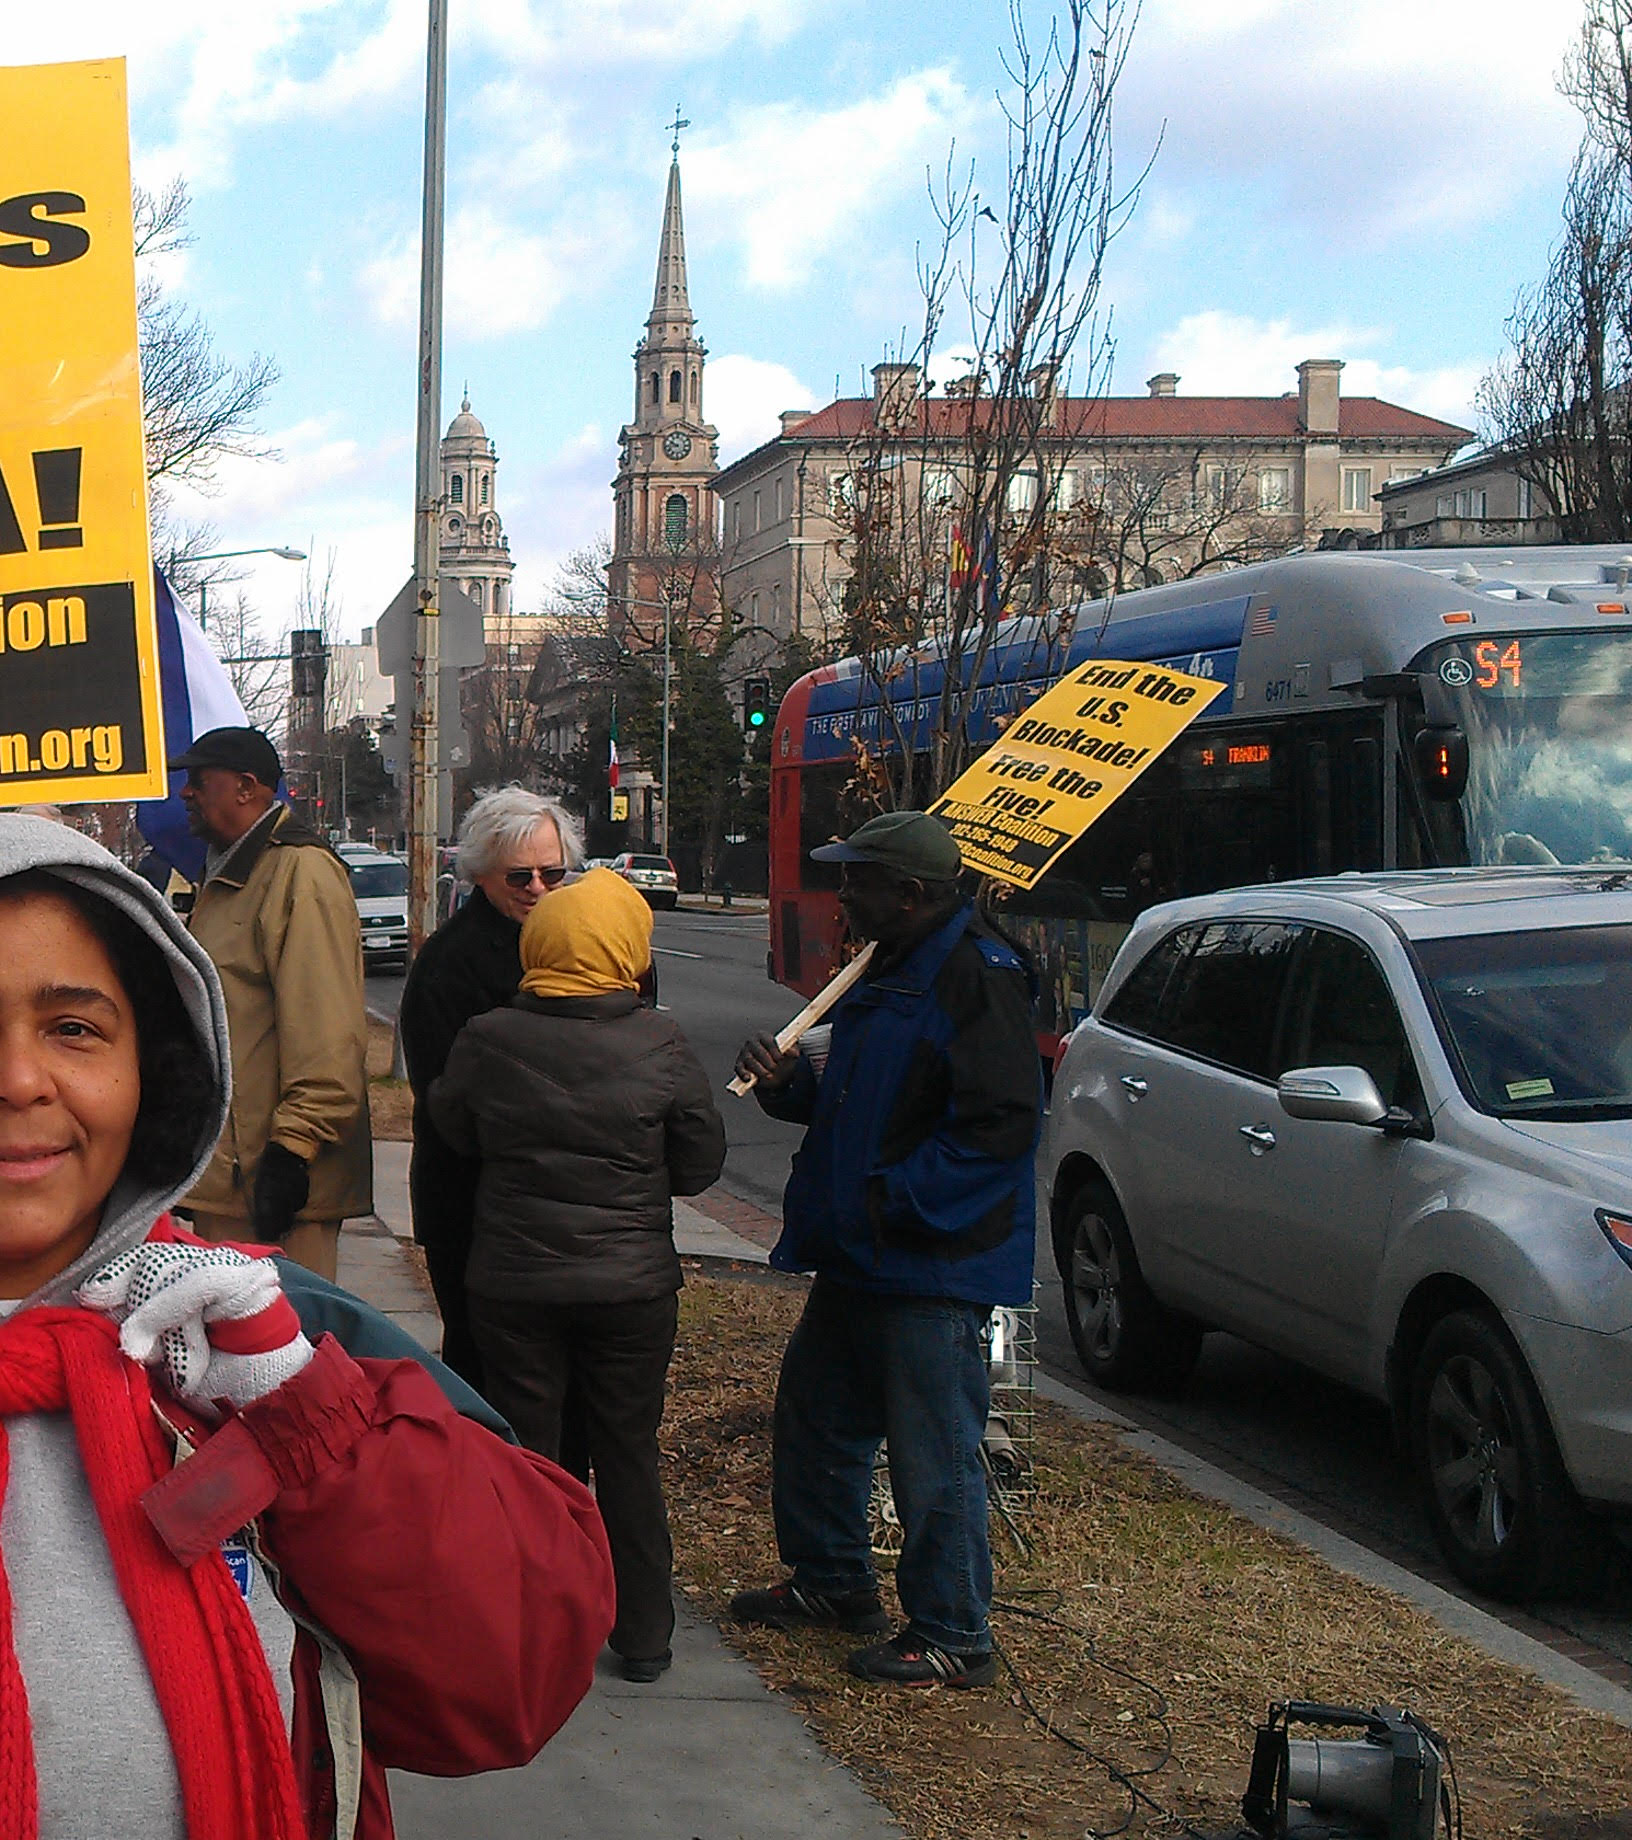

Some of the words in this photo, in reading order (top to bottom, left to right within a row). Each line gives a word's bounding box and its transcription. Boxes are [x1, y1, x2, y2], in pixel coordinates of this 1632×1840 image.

[1074, 664, 1137, 690] End
[1133, 672, 1197, 706] the
[1475, 640, 1522, 688] S4
[1075, 696, 1130, 728] U.S.
[1010, 718, 1152, 770] Blockade!
[986, 753, 1048, 784] Free
[1047, 767, 1103, 800] the
[939, 802, 997, 825] ANSWER
[990, 812, 1060, 848] Coalition
[980, 785, 1056, 820] Five!
